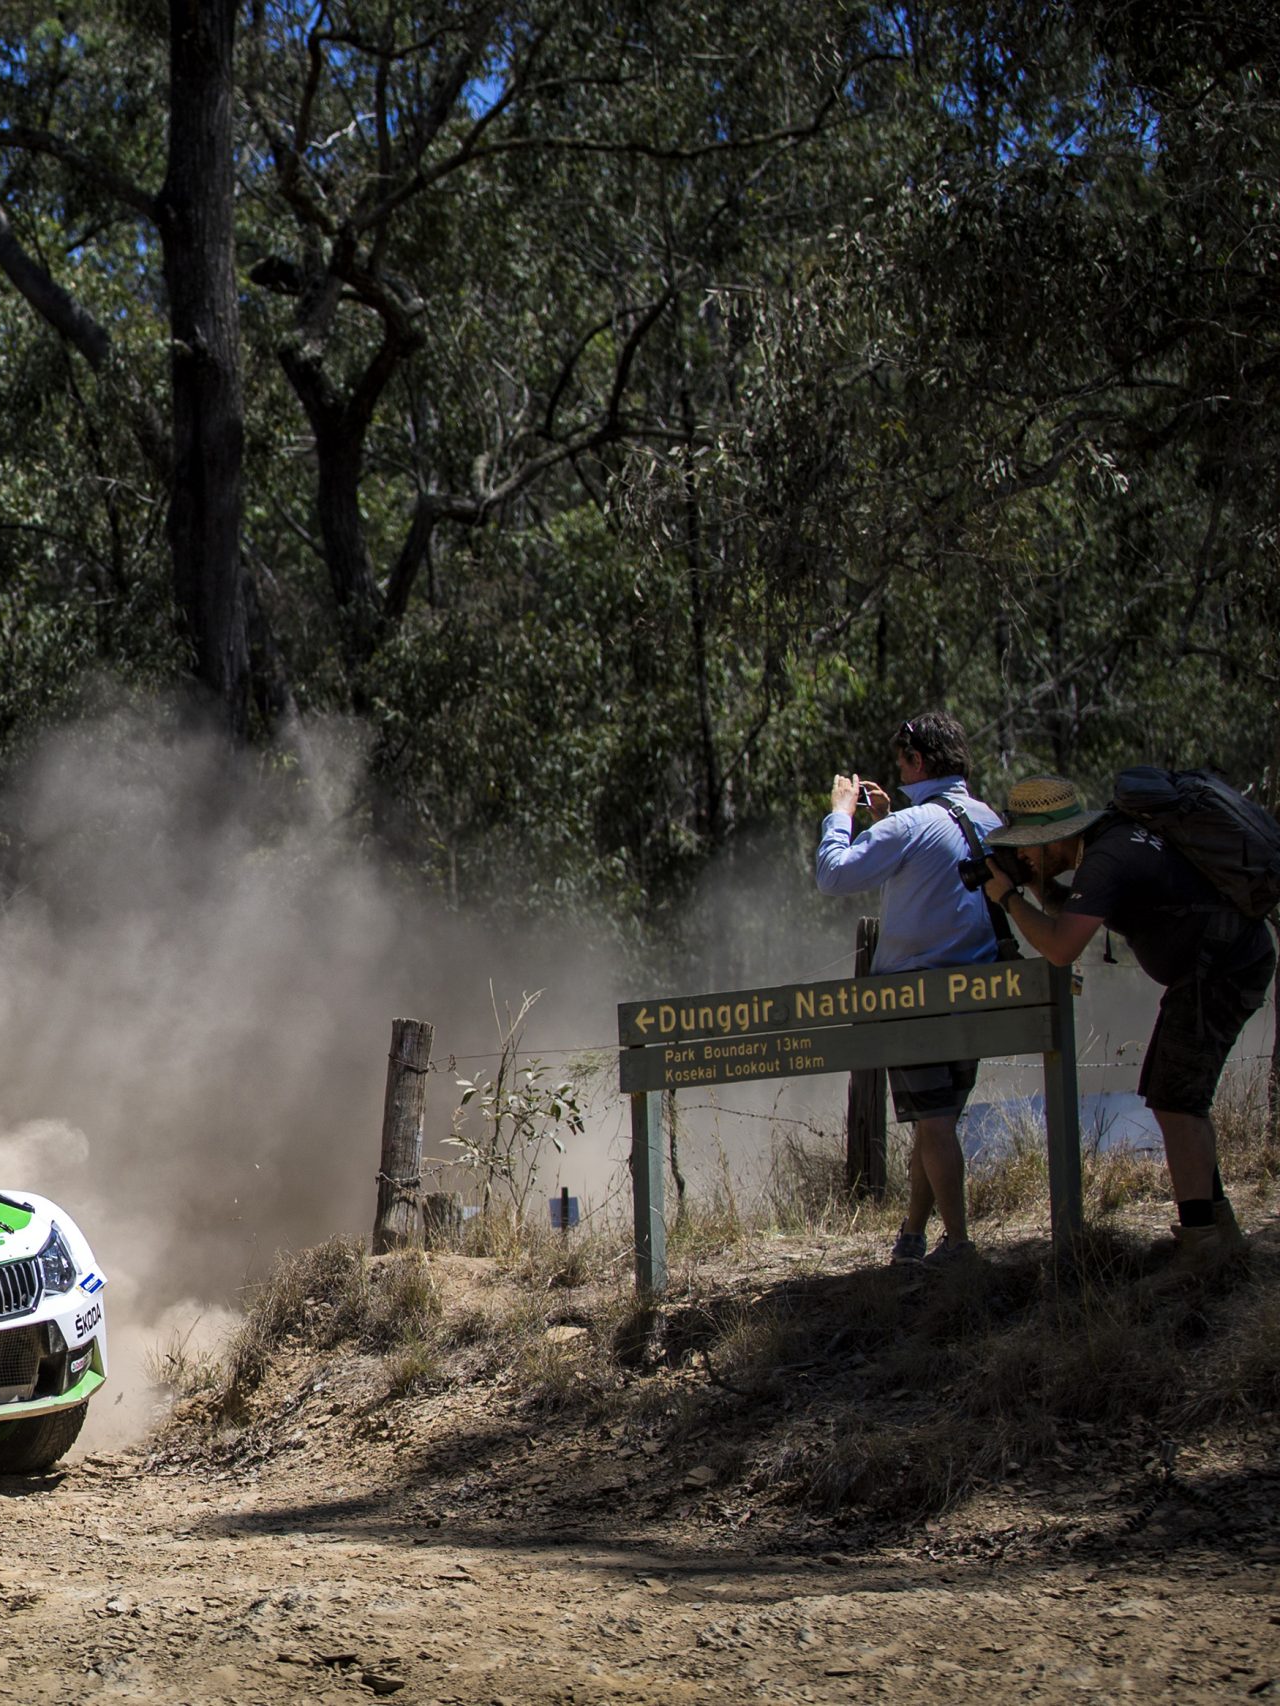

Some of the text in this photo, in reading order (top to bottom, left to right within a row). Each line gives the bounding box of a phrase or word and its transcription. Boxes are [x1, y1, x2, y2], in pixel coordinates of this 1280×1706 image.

[659, 968, 1022, 1034] Dunggir National Park
[665, 1037, 812, 1063] Park Boundary 13km
[665, 1055, 825, 1084] Kosekai Lookout 18km
[75, 1303, 102, 1339] ŠKODA
